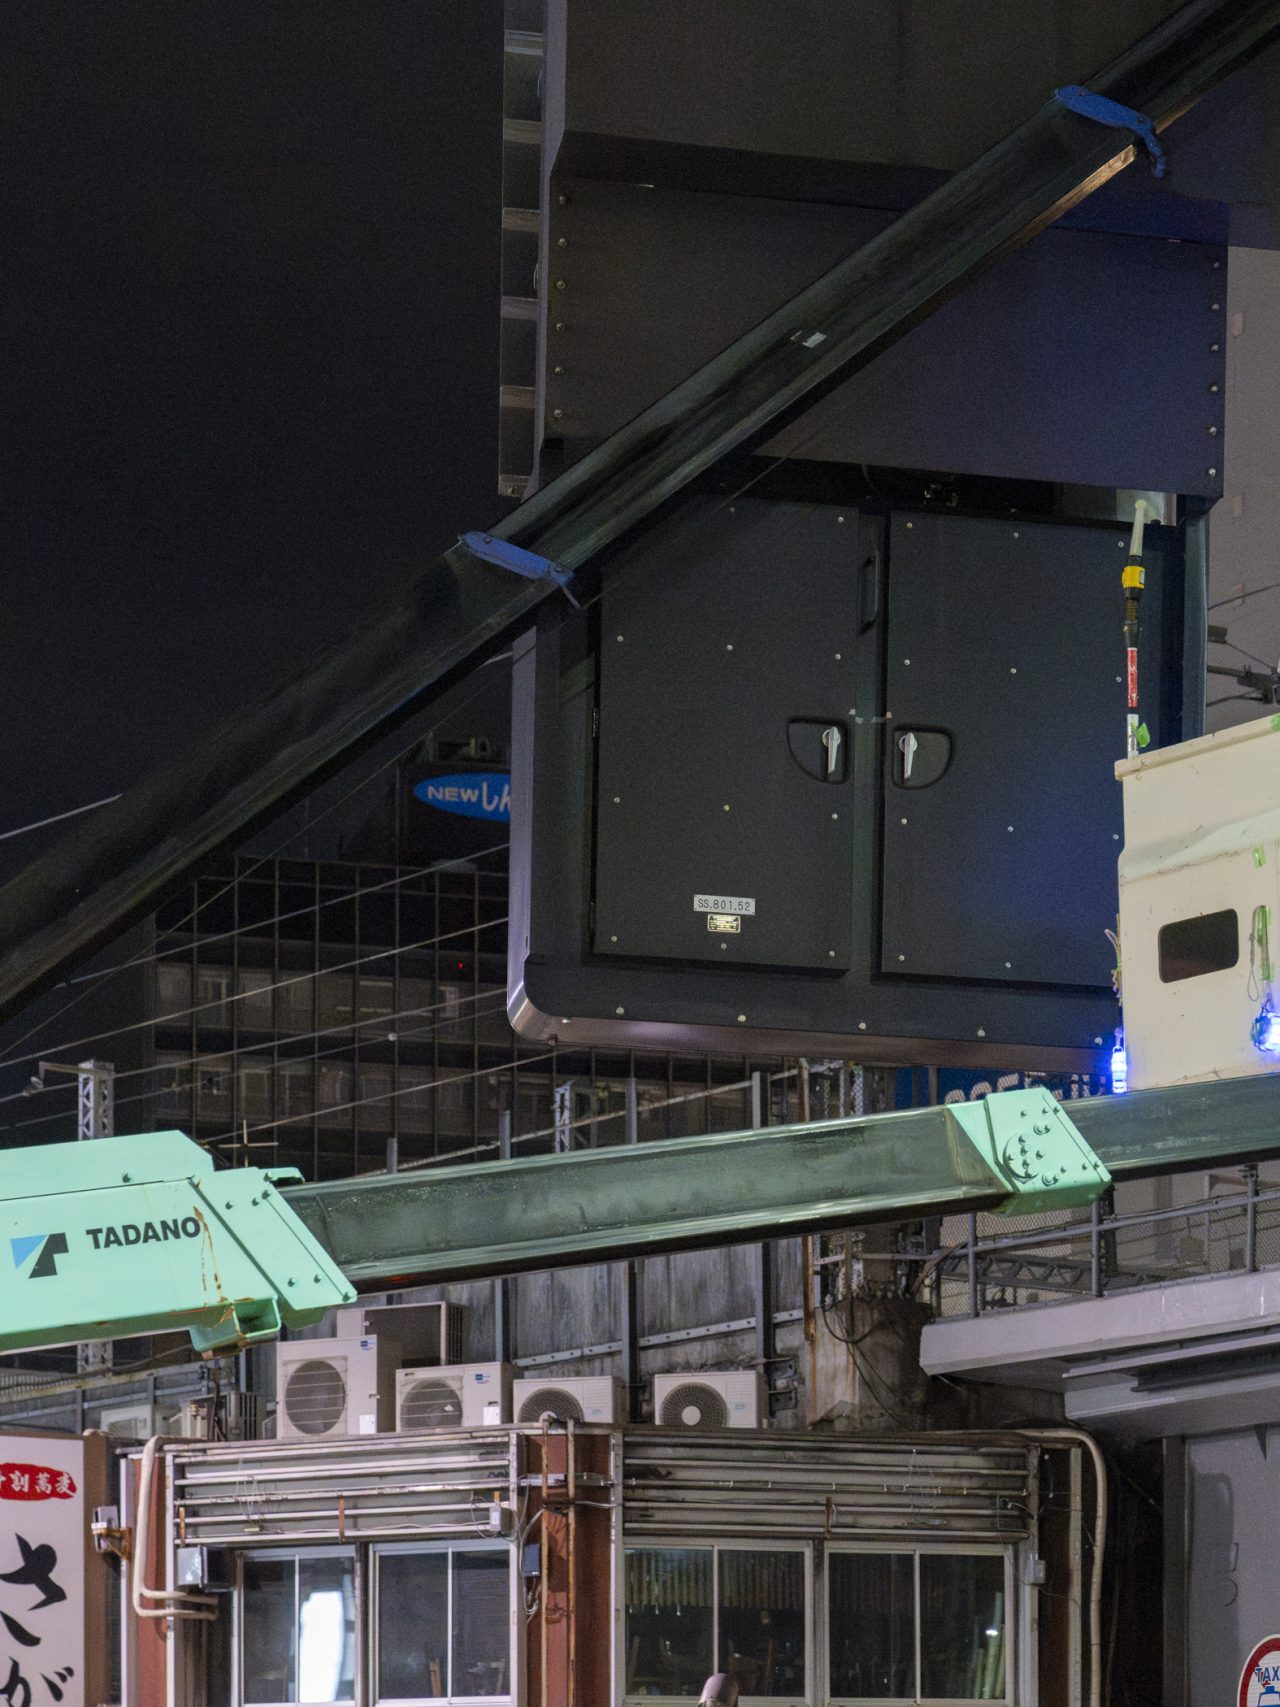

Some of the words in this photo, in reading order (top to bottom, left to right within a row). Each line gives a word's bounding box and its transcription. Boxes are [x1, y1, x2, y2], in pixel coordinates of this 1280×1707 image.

[427, 785, 479, 803] NEW
[697, 898, 751, 912] SS.801.52
[85, 1216, 201, 1250] TADANO
